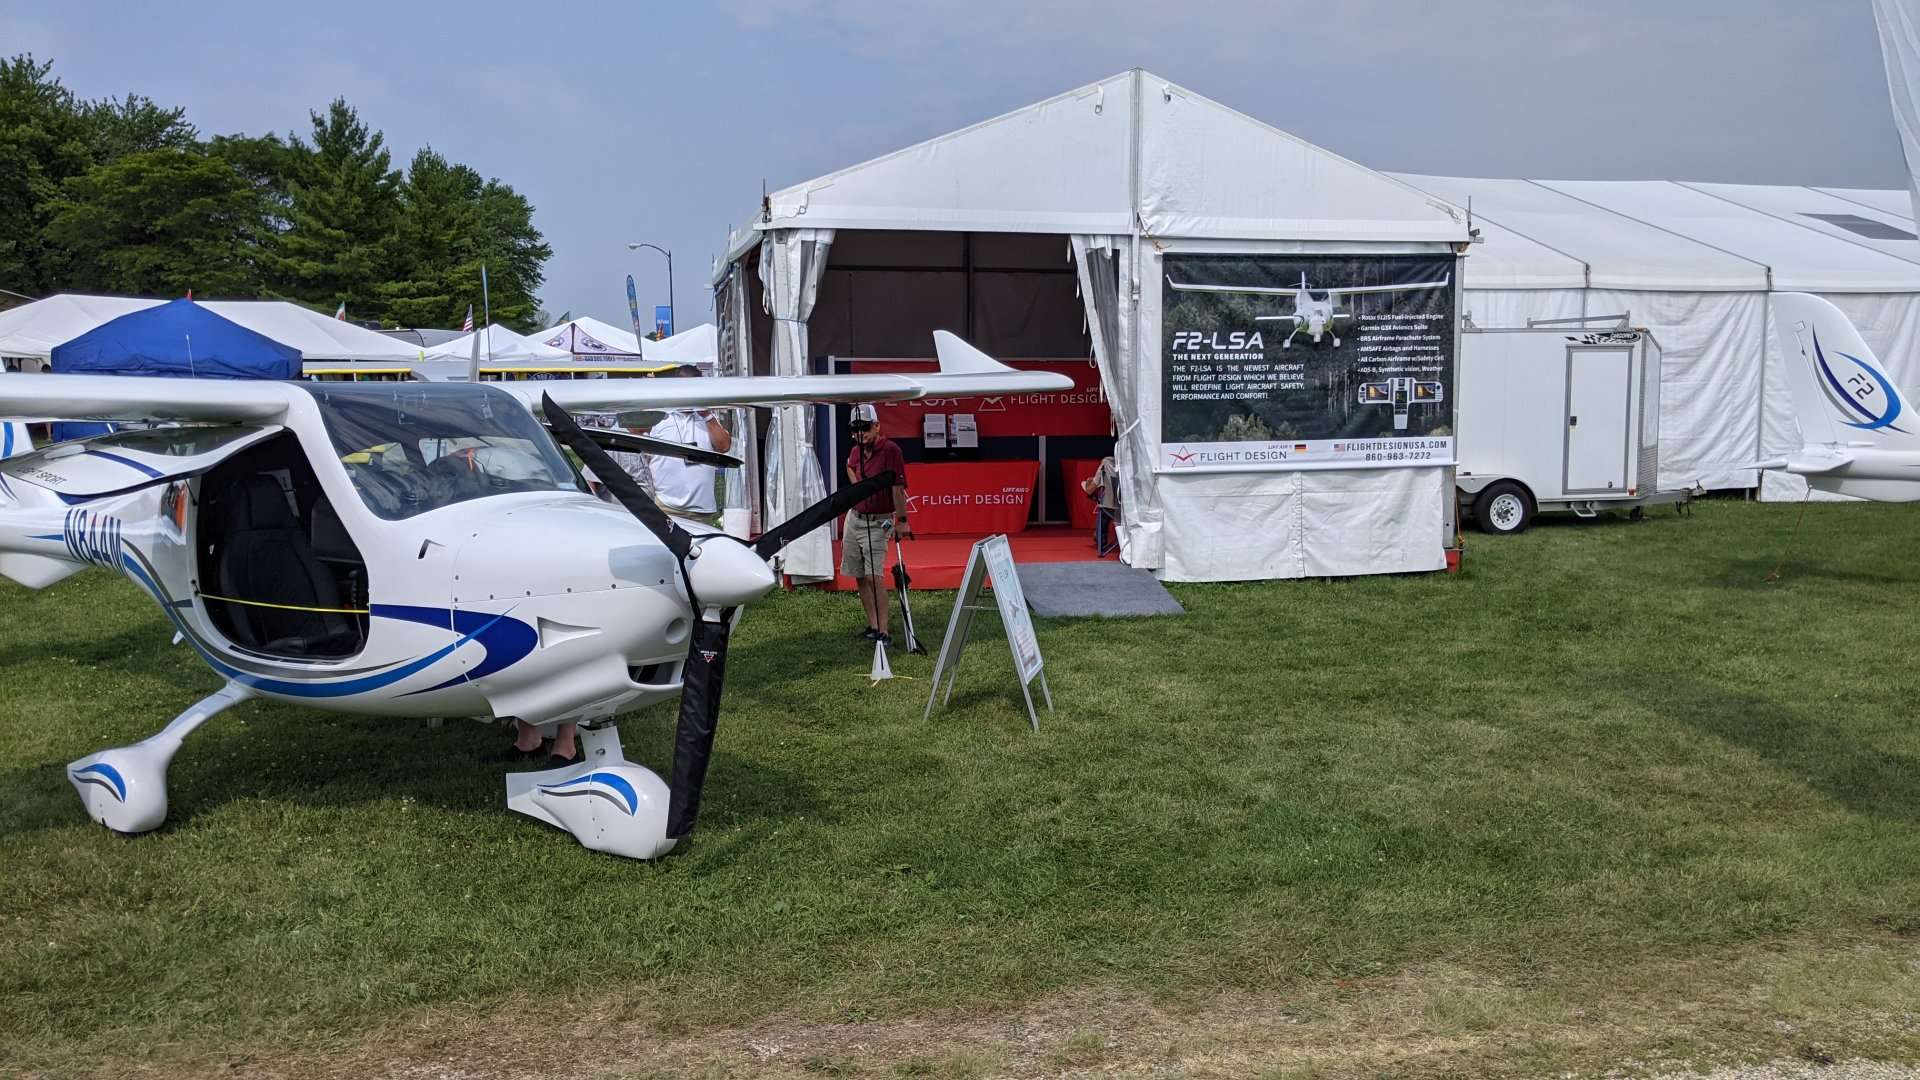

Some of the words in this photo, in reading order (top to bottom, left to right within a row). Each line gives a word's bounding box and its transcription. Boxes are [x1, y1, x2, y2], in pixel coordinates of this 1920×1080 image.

[1172, 331, 1264, 350] F2-LSA
[1244, 364, 1270, 372] NEWEST
[1193, 374, 1216, 382] FLIGHT
[1191, 383, 1222, 391] REDEFINE
[1280, 382, 1305, 390] SAFETY,
[1010, 395, 1056, 405] FLIGHT
[1346, 441, 1447, 452] FLIGHTDESIGNUSA.COM
[1200, 452, 1241, 461] FLIGHT
[1245, 451, 1287, 460] DESIGN
[922, 495, 970, 505] FLIGHT
[975, 495, 1024, 504] DESIGN
